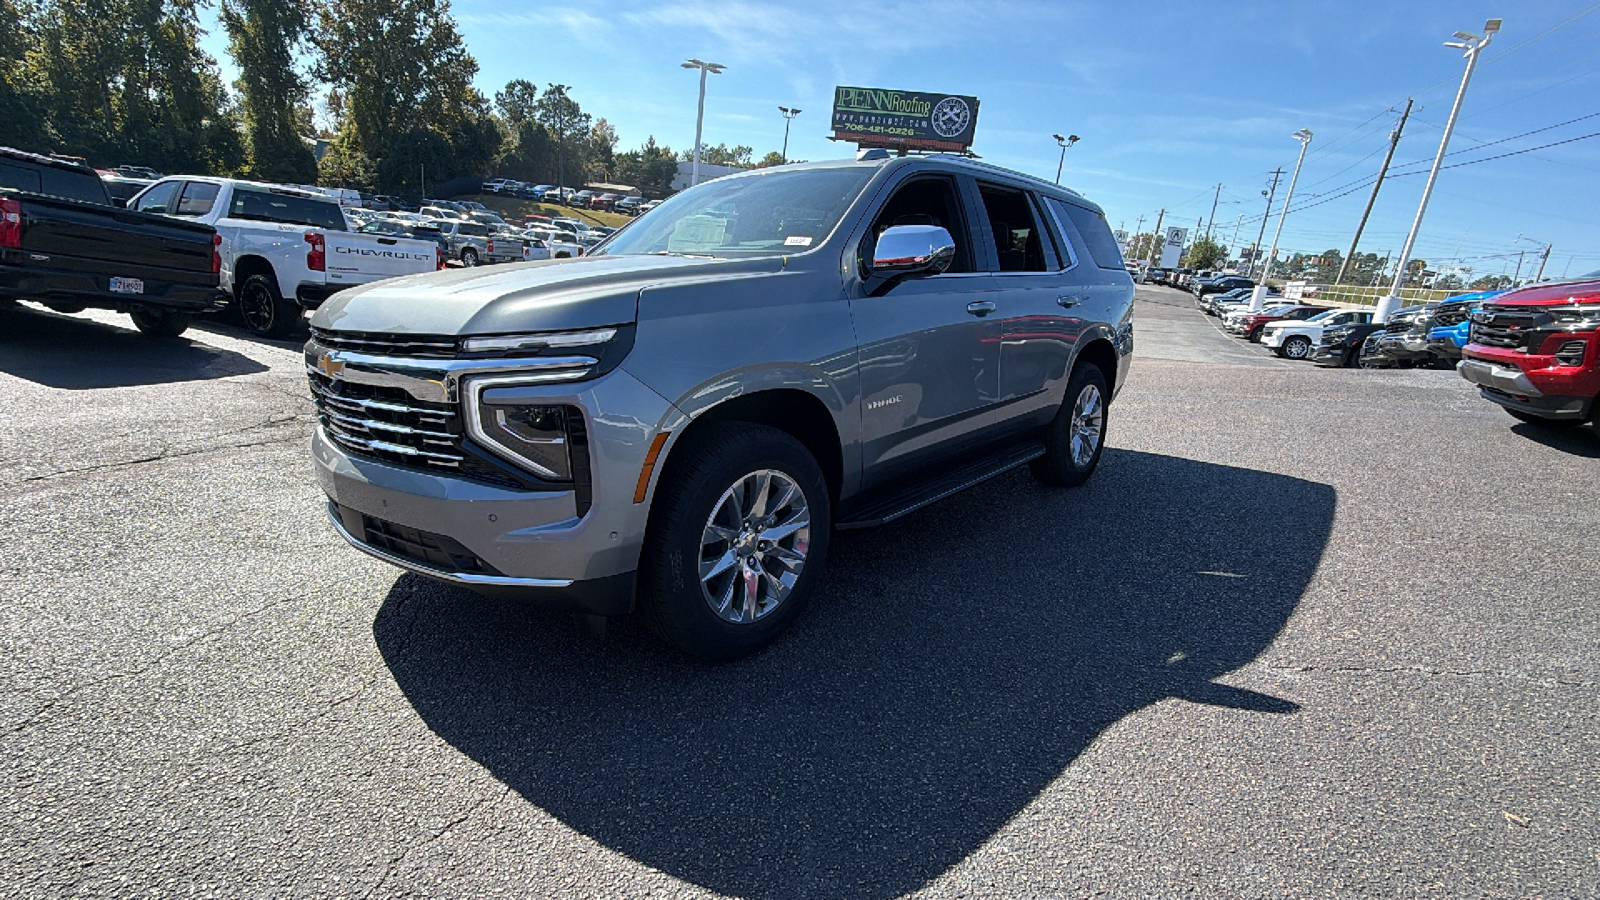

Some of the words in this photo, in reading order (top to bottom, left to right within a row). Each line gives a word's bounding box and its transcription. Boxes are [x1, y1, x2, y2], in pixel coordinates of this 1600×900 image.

[838, 87, 905, 111] PENN
[892, 94, 931, 118] Roofing
[335, 246, 431, 261] CHEVROLET
[866, 395, 903, 409] TAHOE
